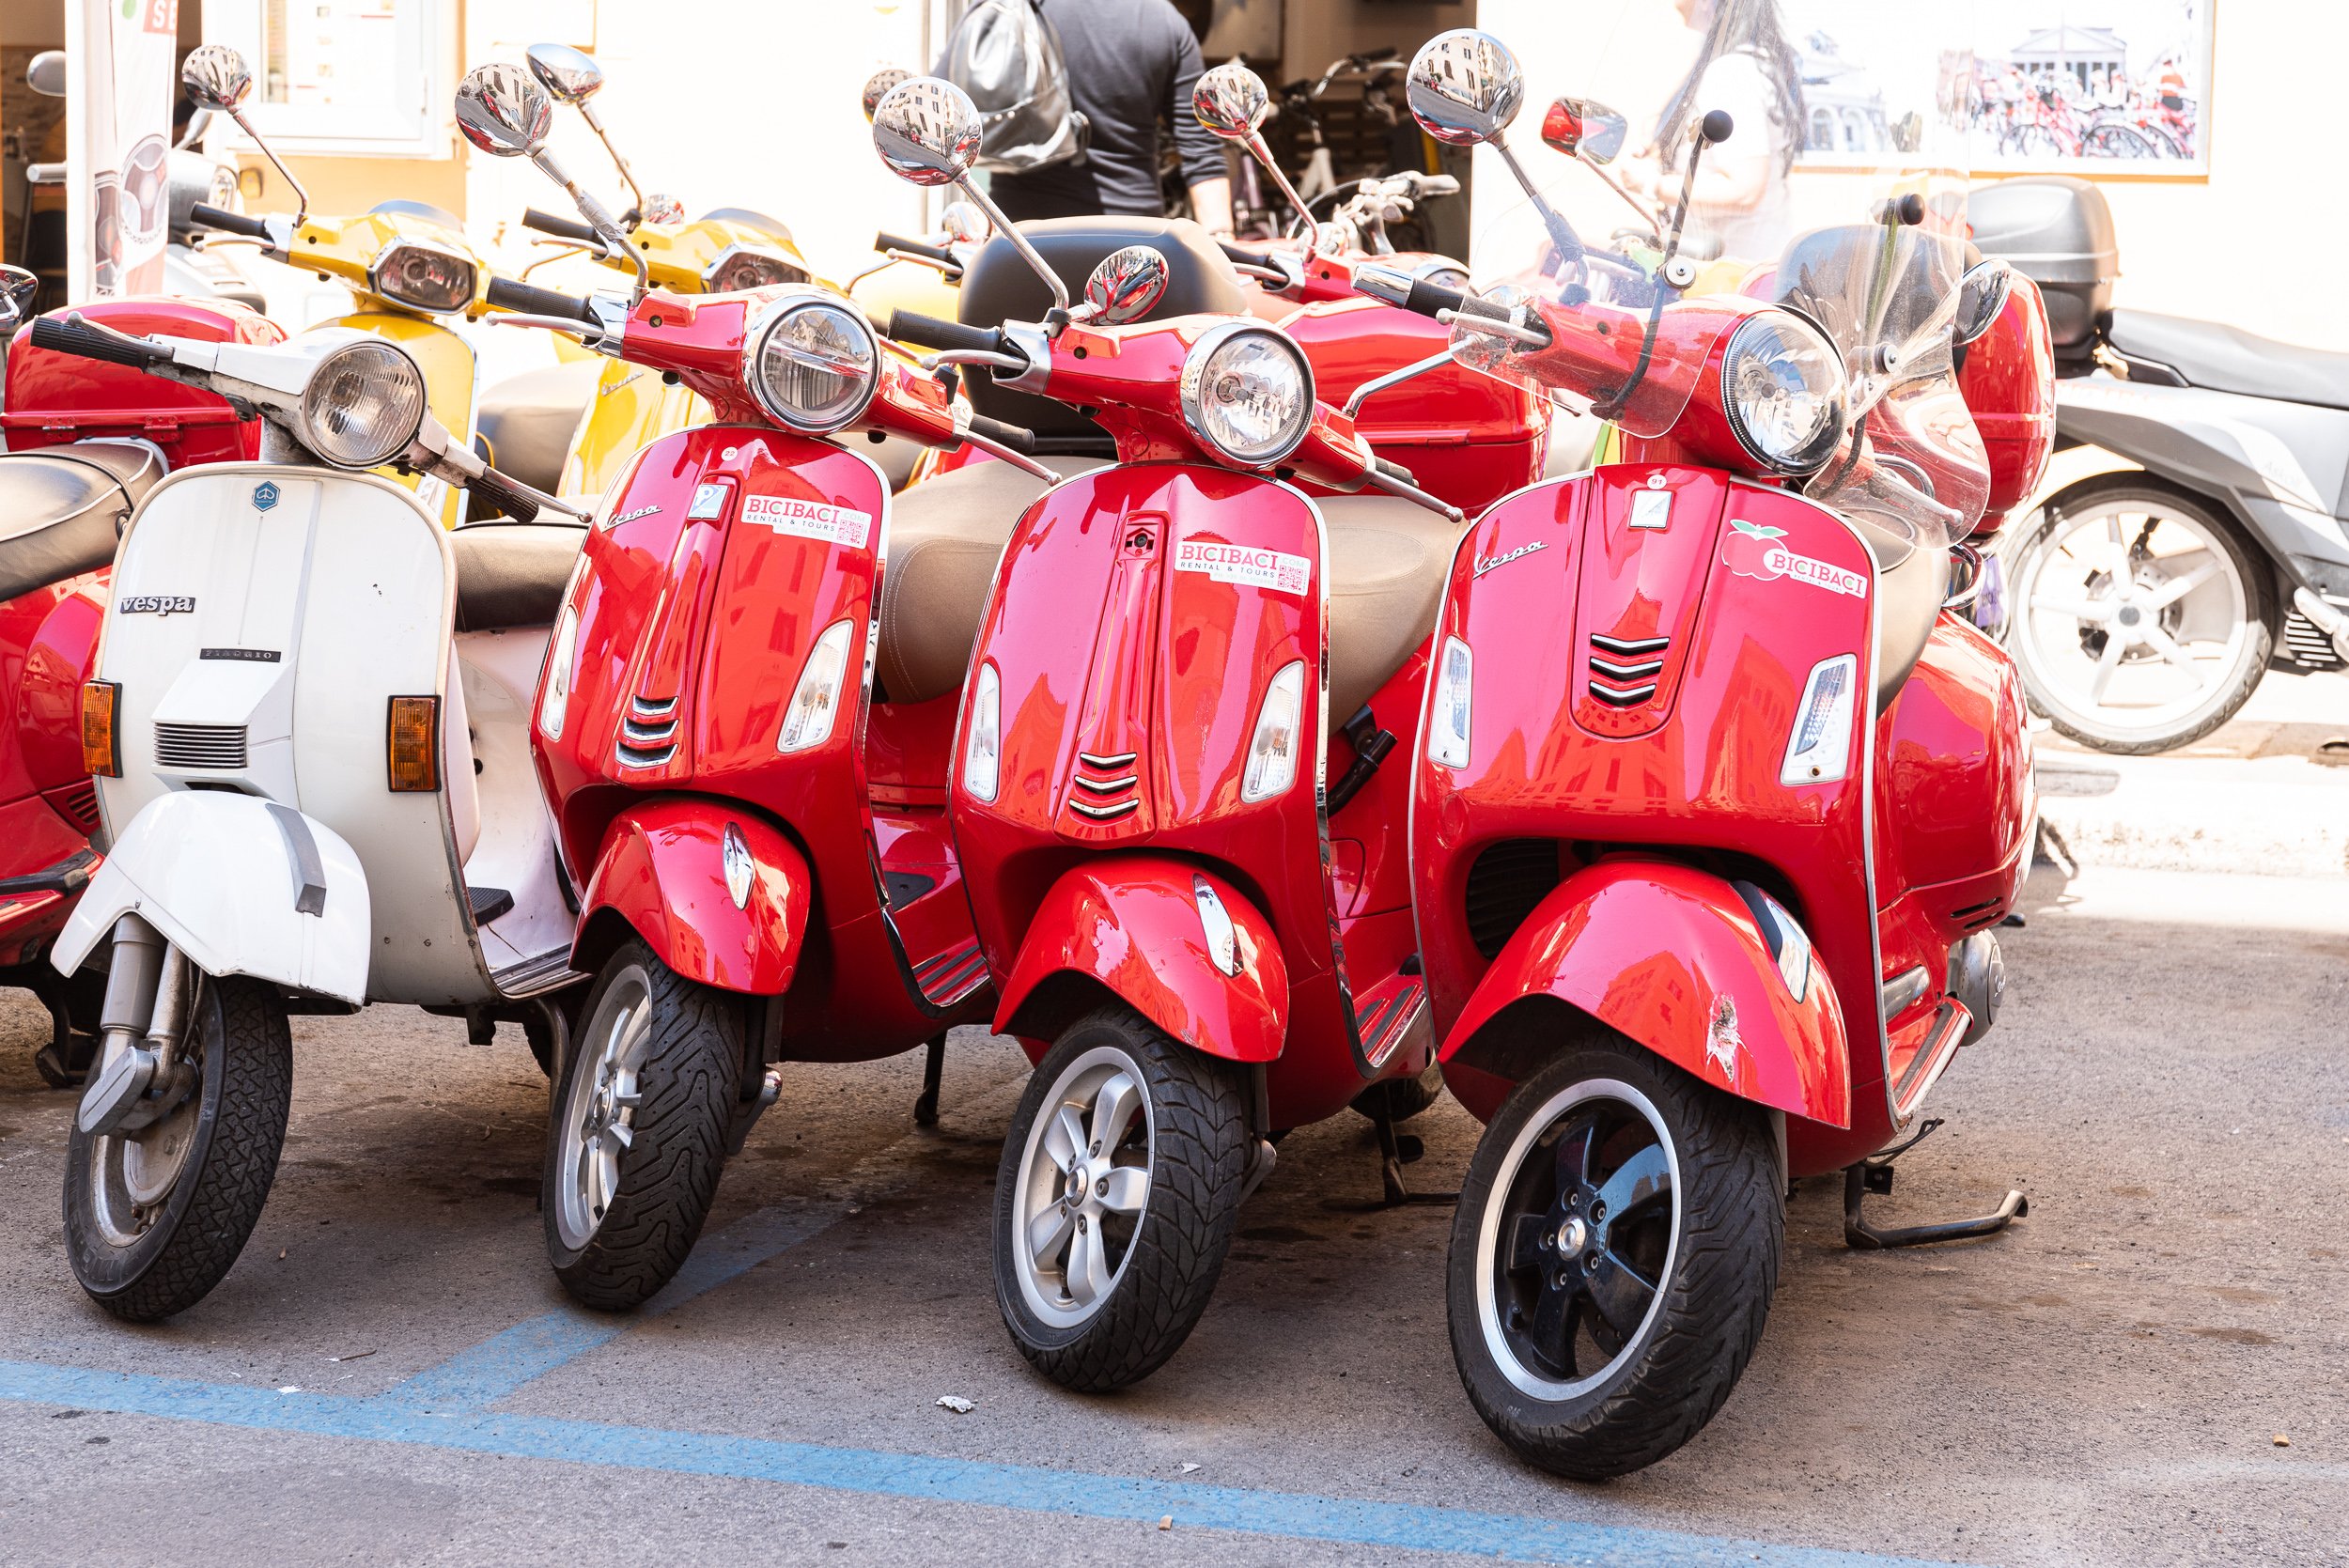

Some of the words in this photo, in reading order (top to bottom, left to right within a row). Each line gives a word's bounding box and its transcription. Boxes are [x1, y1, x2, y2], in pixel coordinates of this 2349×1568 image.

[746, 514, 783, 524] RENTAL
[802, 520, 835, 532] TOURS
[747, 499, 840, 524] BICIBACI
[1180, 545, 1279, 570] BICIBACI
[1180, 561, 1220, 571] RENTAL
[1240, 567, 1275, 579] TOURS
[1472, 540, 1549, 581] Vespa
[1771, 553, 1863, 595] BICIBACI
[120, 597, 194, 616] vespa
